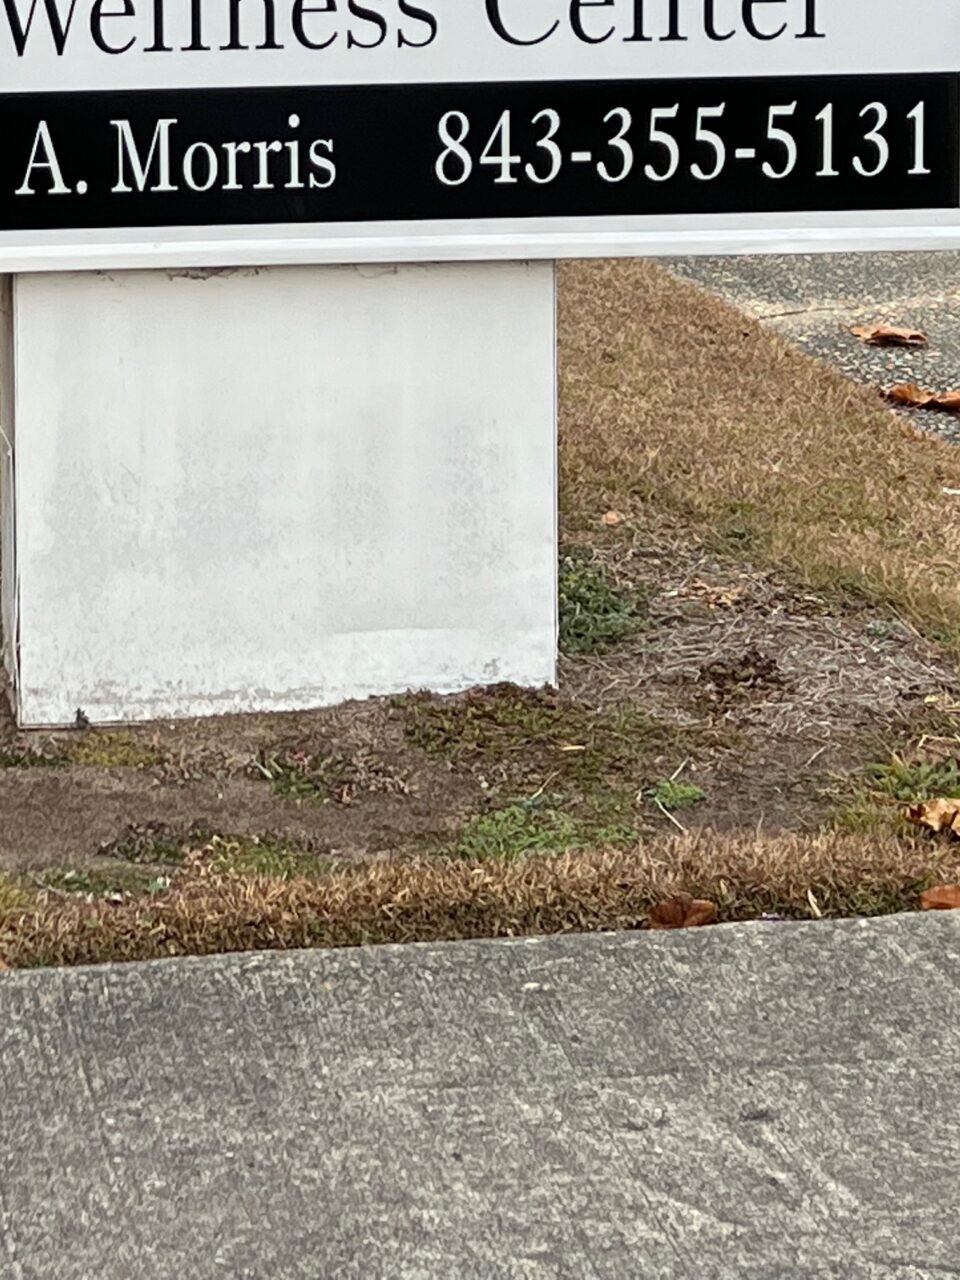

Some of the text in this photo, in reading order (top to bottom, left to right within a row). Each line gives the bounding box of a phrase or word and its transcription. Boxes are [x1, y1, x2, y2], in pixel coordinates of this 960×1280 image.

[15, 120, 88, 195] A.
[110, 113, 336, 193] Morris
[435, 100, 931, 186] 843-355-5131
